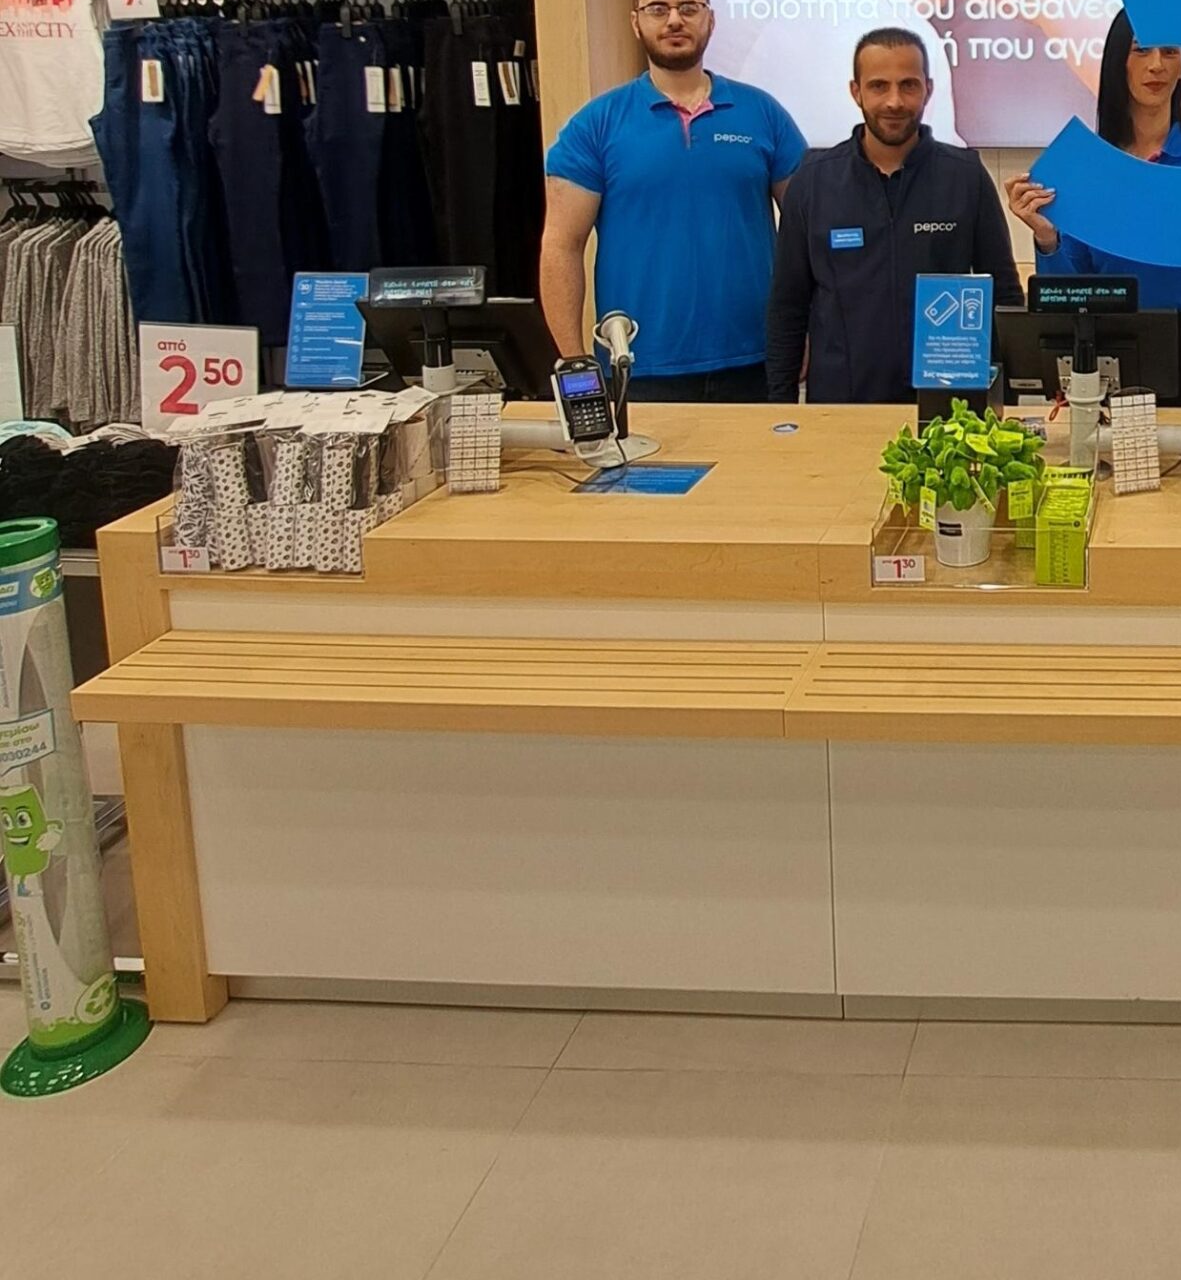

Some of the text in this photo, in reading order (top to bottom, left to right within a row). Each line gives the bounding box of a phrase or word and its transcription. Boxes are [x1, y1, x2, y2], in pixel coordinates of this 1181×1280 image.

[35, 22, 74, 38] CITY
[968, 38, 1033, 60] που
[714, 133, 749, 144] pepco
[914, 222, 953, 234] pepco
[157, 340, 186, 351] από
